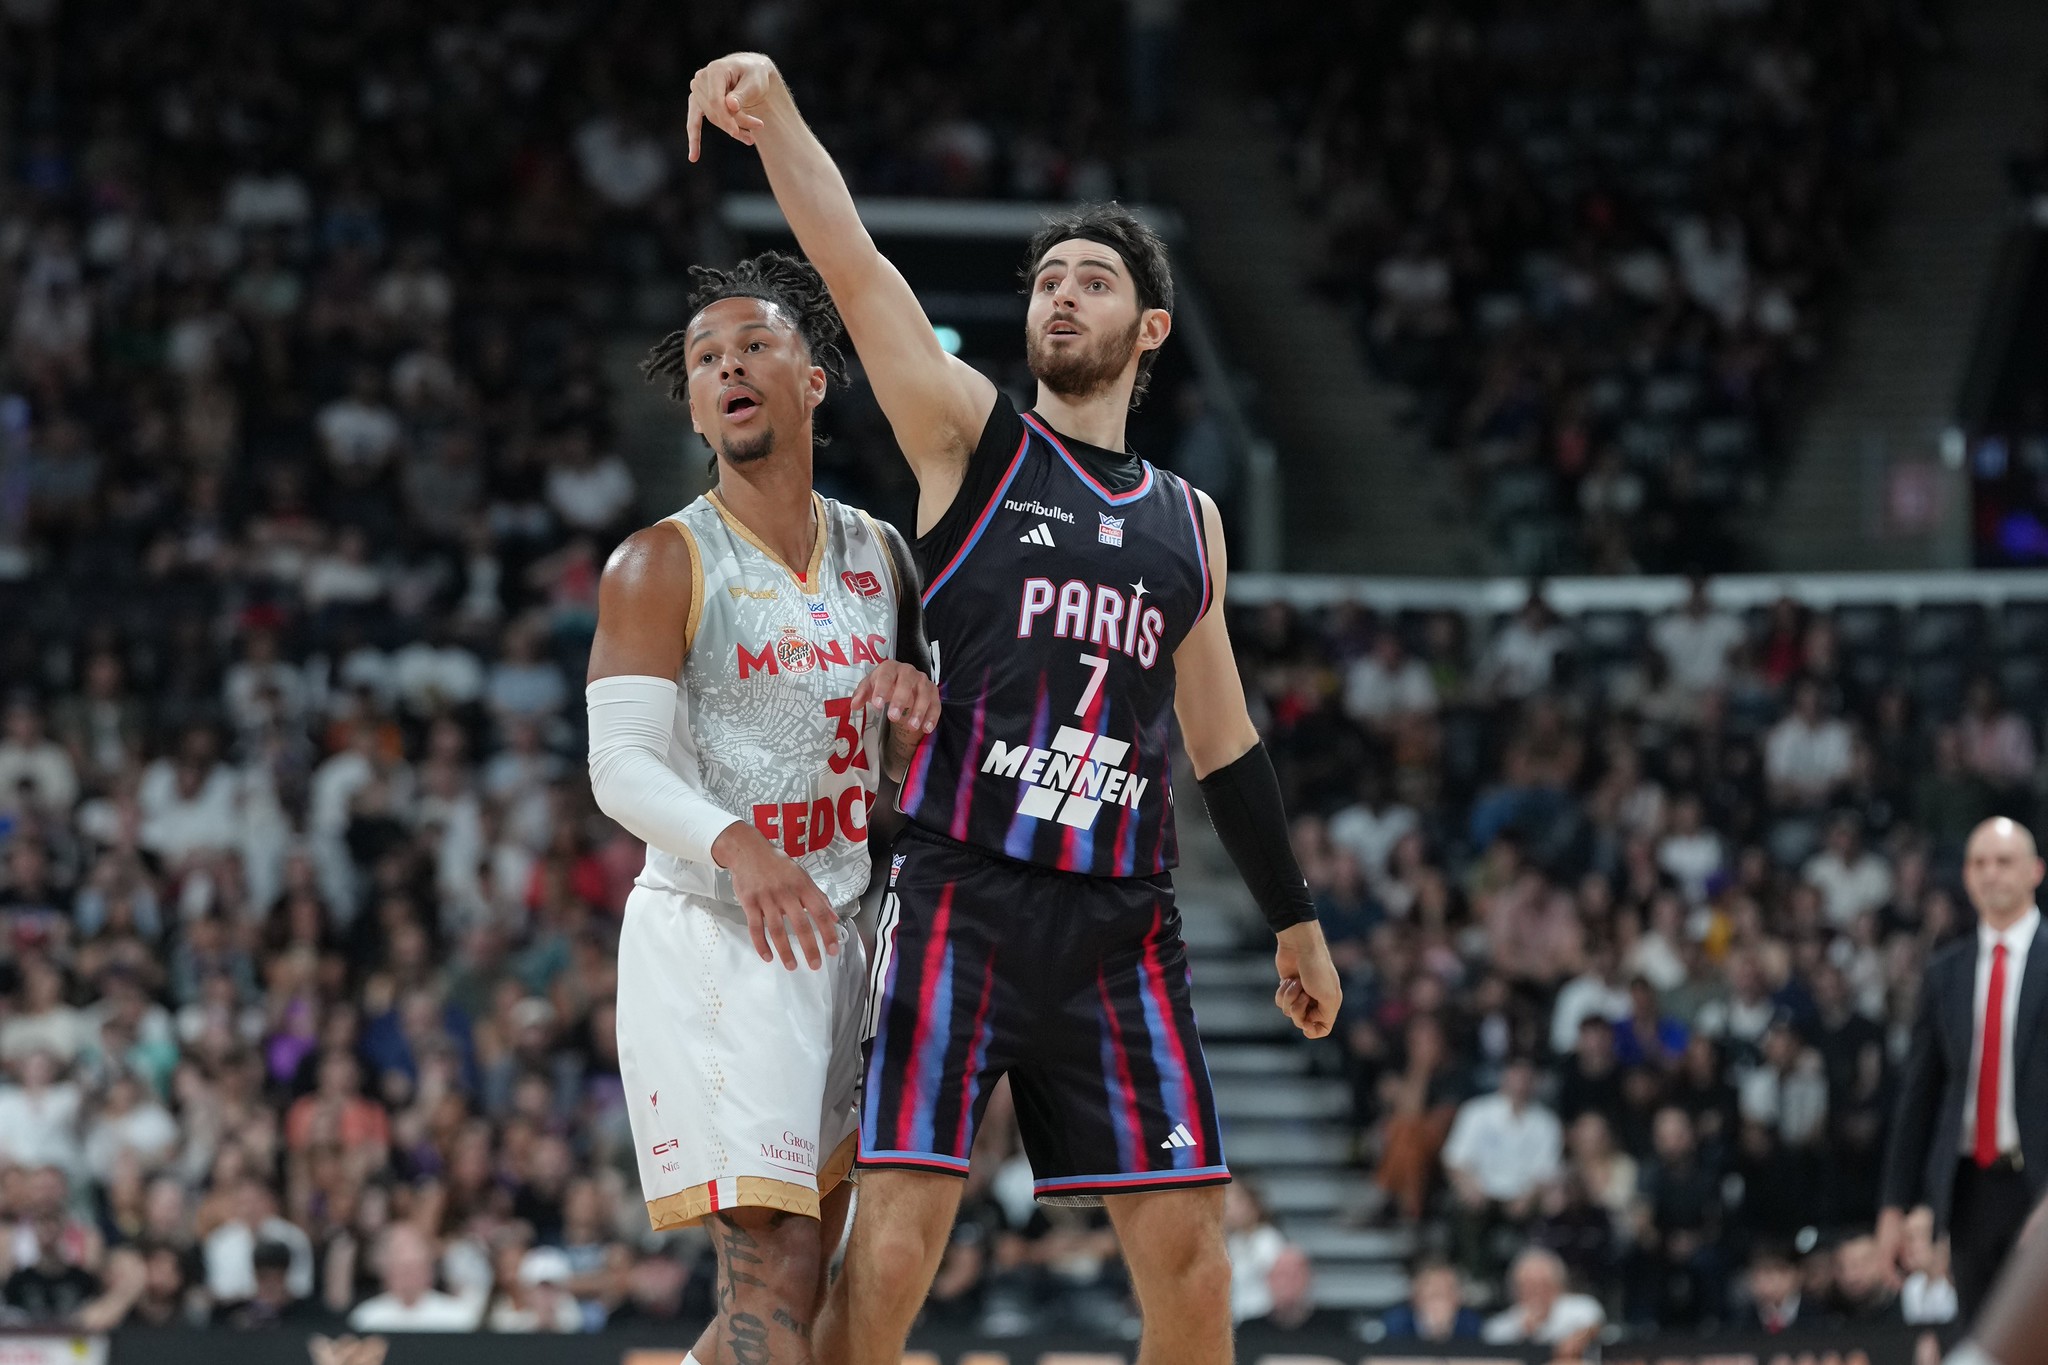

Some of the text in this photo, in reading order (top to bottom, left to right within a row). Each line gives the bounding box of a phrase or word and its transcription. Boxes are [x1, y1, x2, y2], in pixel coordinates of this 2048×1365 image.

[736, 632, 889, 680] MONAC
[778, 642, 811, 660] Roca
[1017, 577, 1165, 670] PARIS
[783, 651, 810, 665] Team
[1074, 653, 1110, 718] 7
[980, 740, 1150, 811] MENNEN
[752, 785, 877, 858] FEDC
